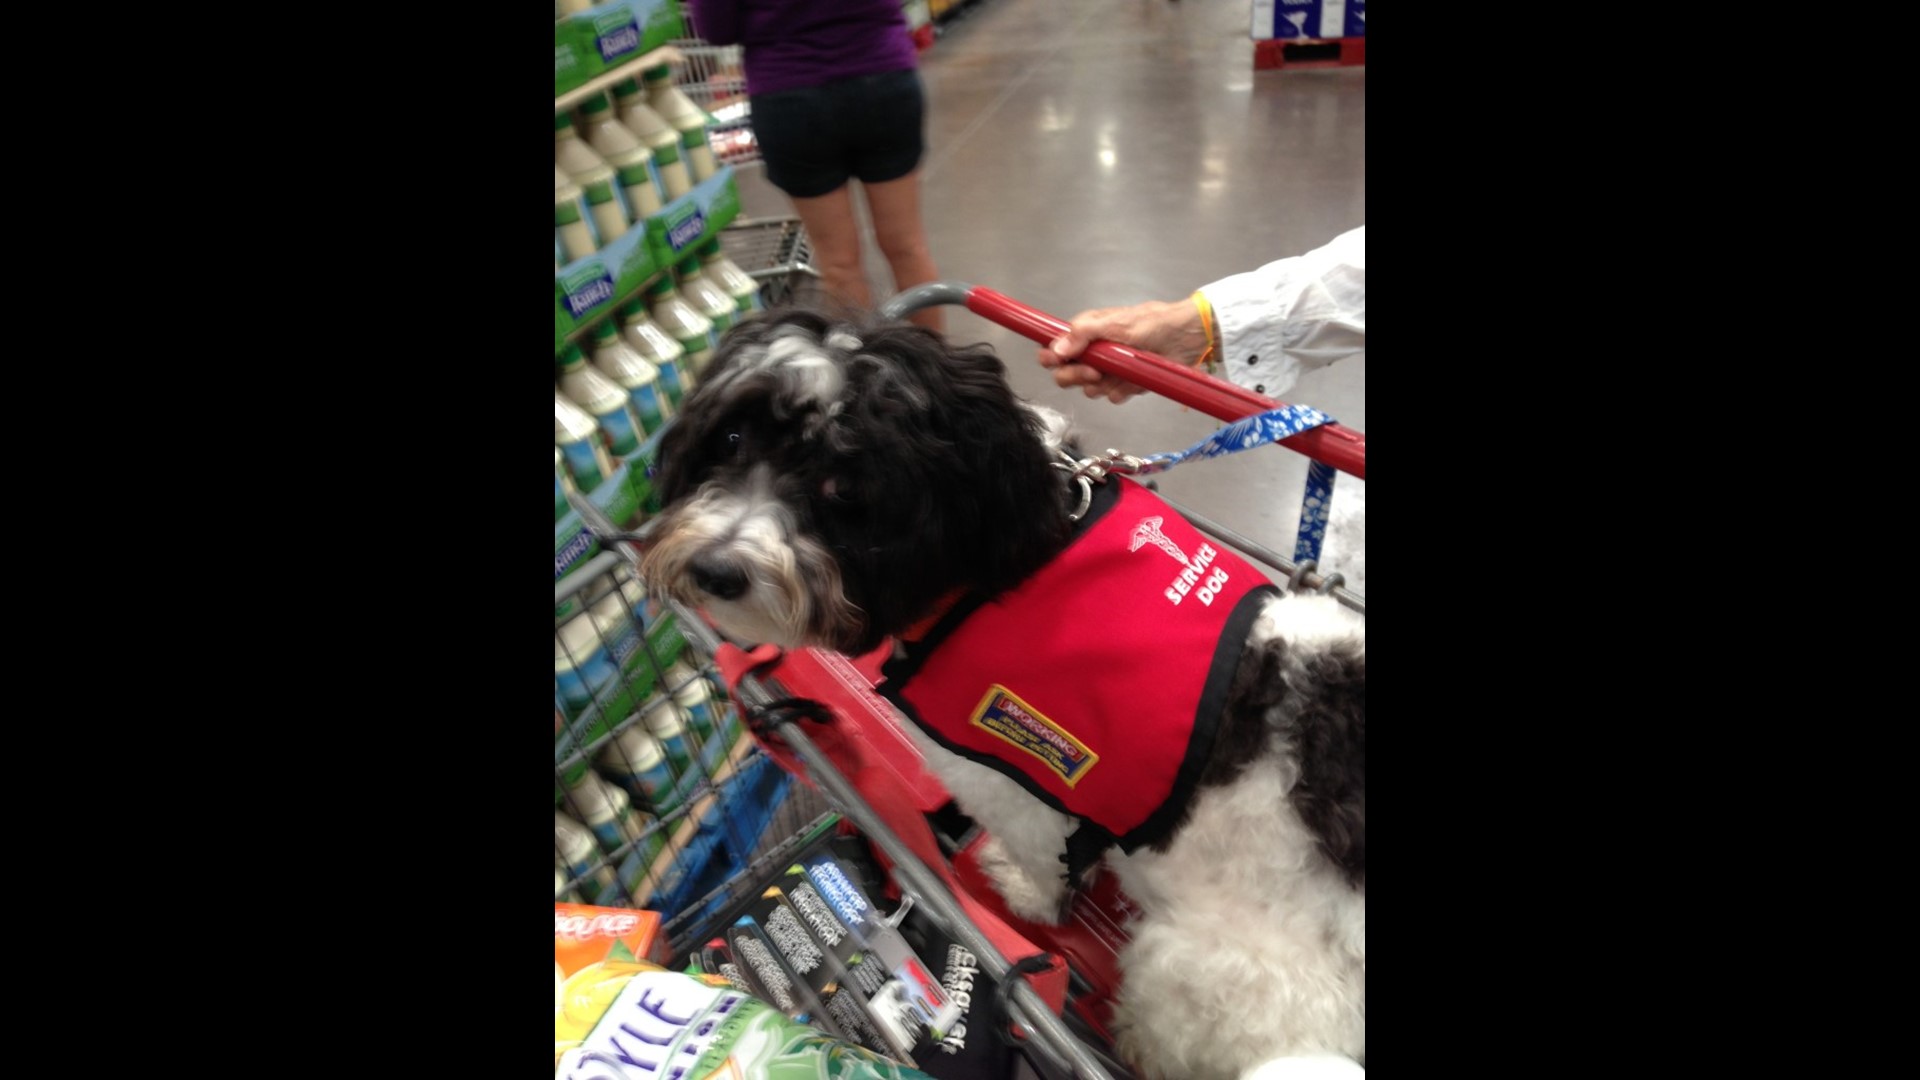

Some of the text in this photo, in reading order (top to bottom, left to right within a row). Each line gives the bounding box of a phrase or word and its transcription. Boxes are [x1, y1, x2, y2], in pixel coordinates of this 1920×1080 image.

[1164, 542, 1217, 606] SERVICE
[1195, 566, 1229, 607] DOG
[1005, 700, 1078, 757] WORKING
